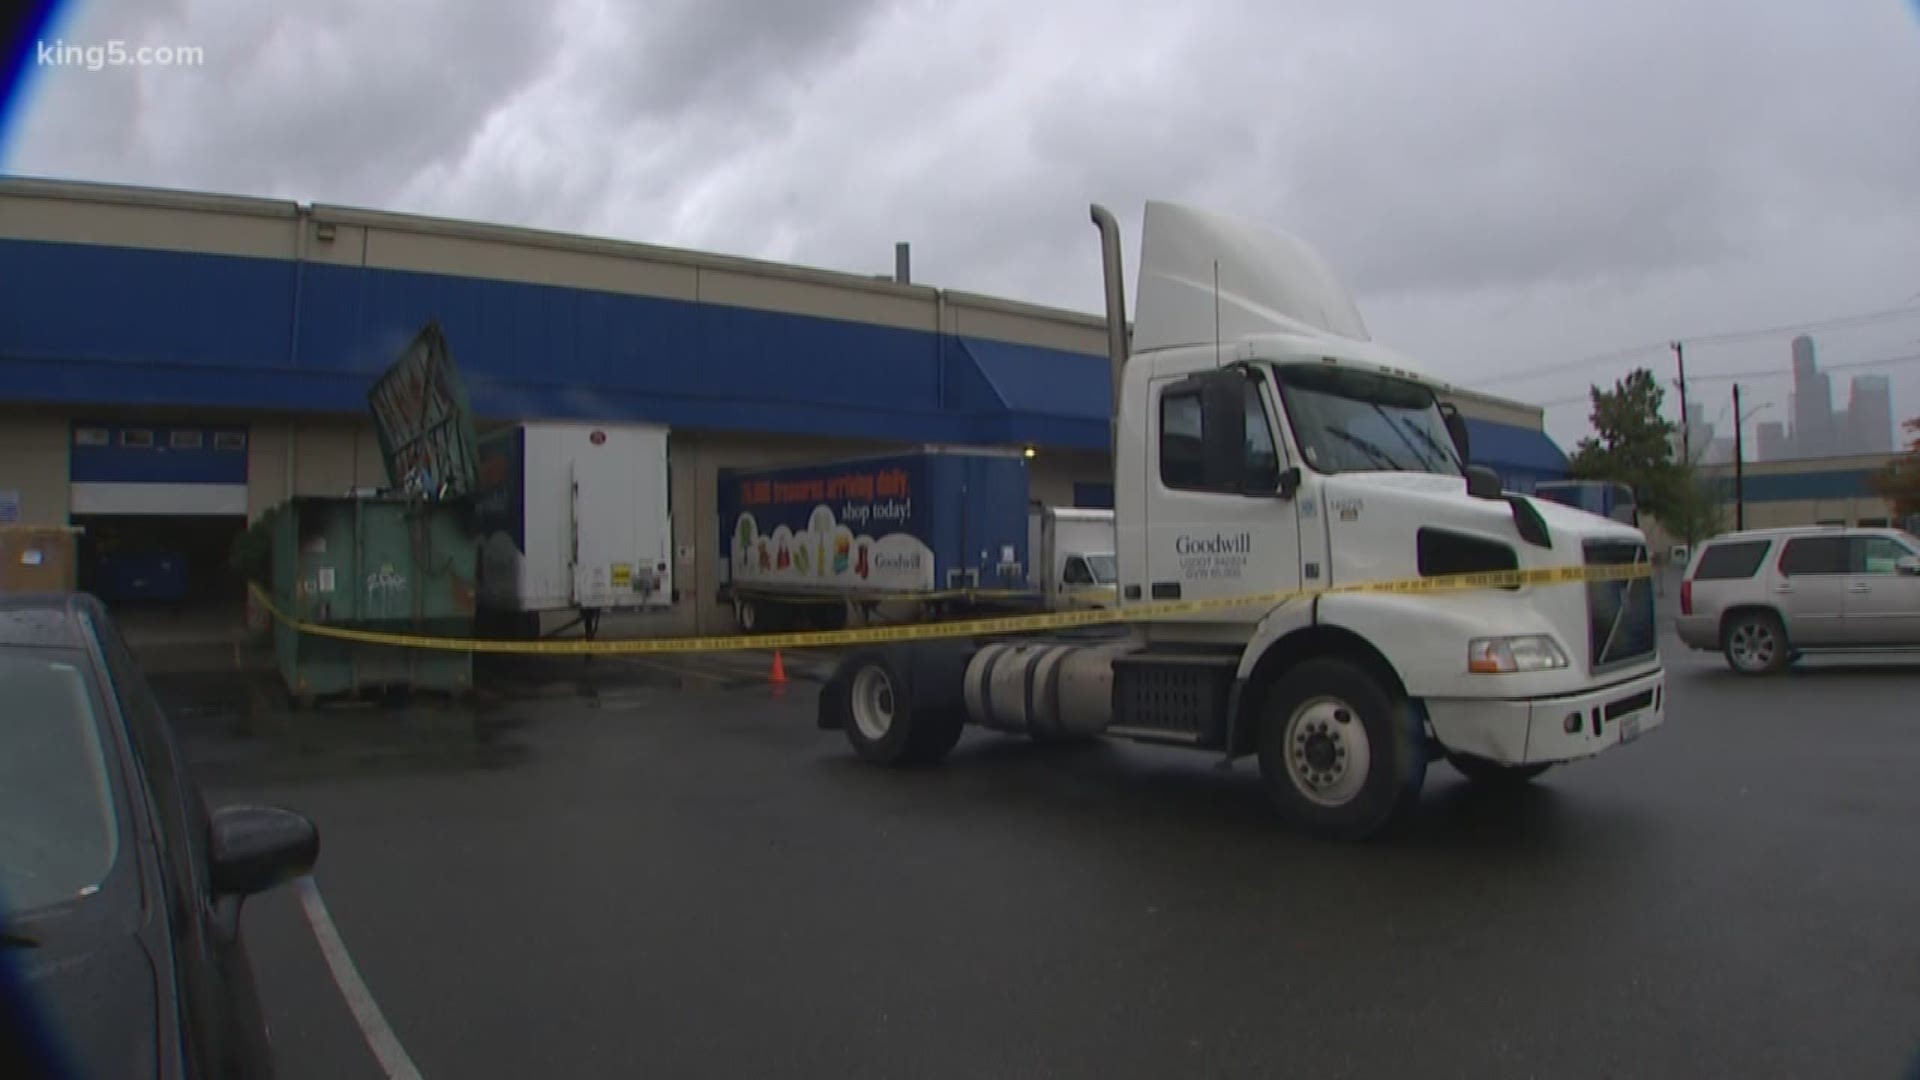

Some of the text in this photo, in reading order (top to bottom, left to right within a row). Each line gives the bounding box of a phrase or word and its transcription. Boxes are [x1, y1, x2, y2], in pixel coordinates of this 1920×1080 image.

[842, 497, 911, 525] shop today!
[1176, 532, 1250, 553] Goodwill
[875, 552, 920, 569] Goodwill
